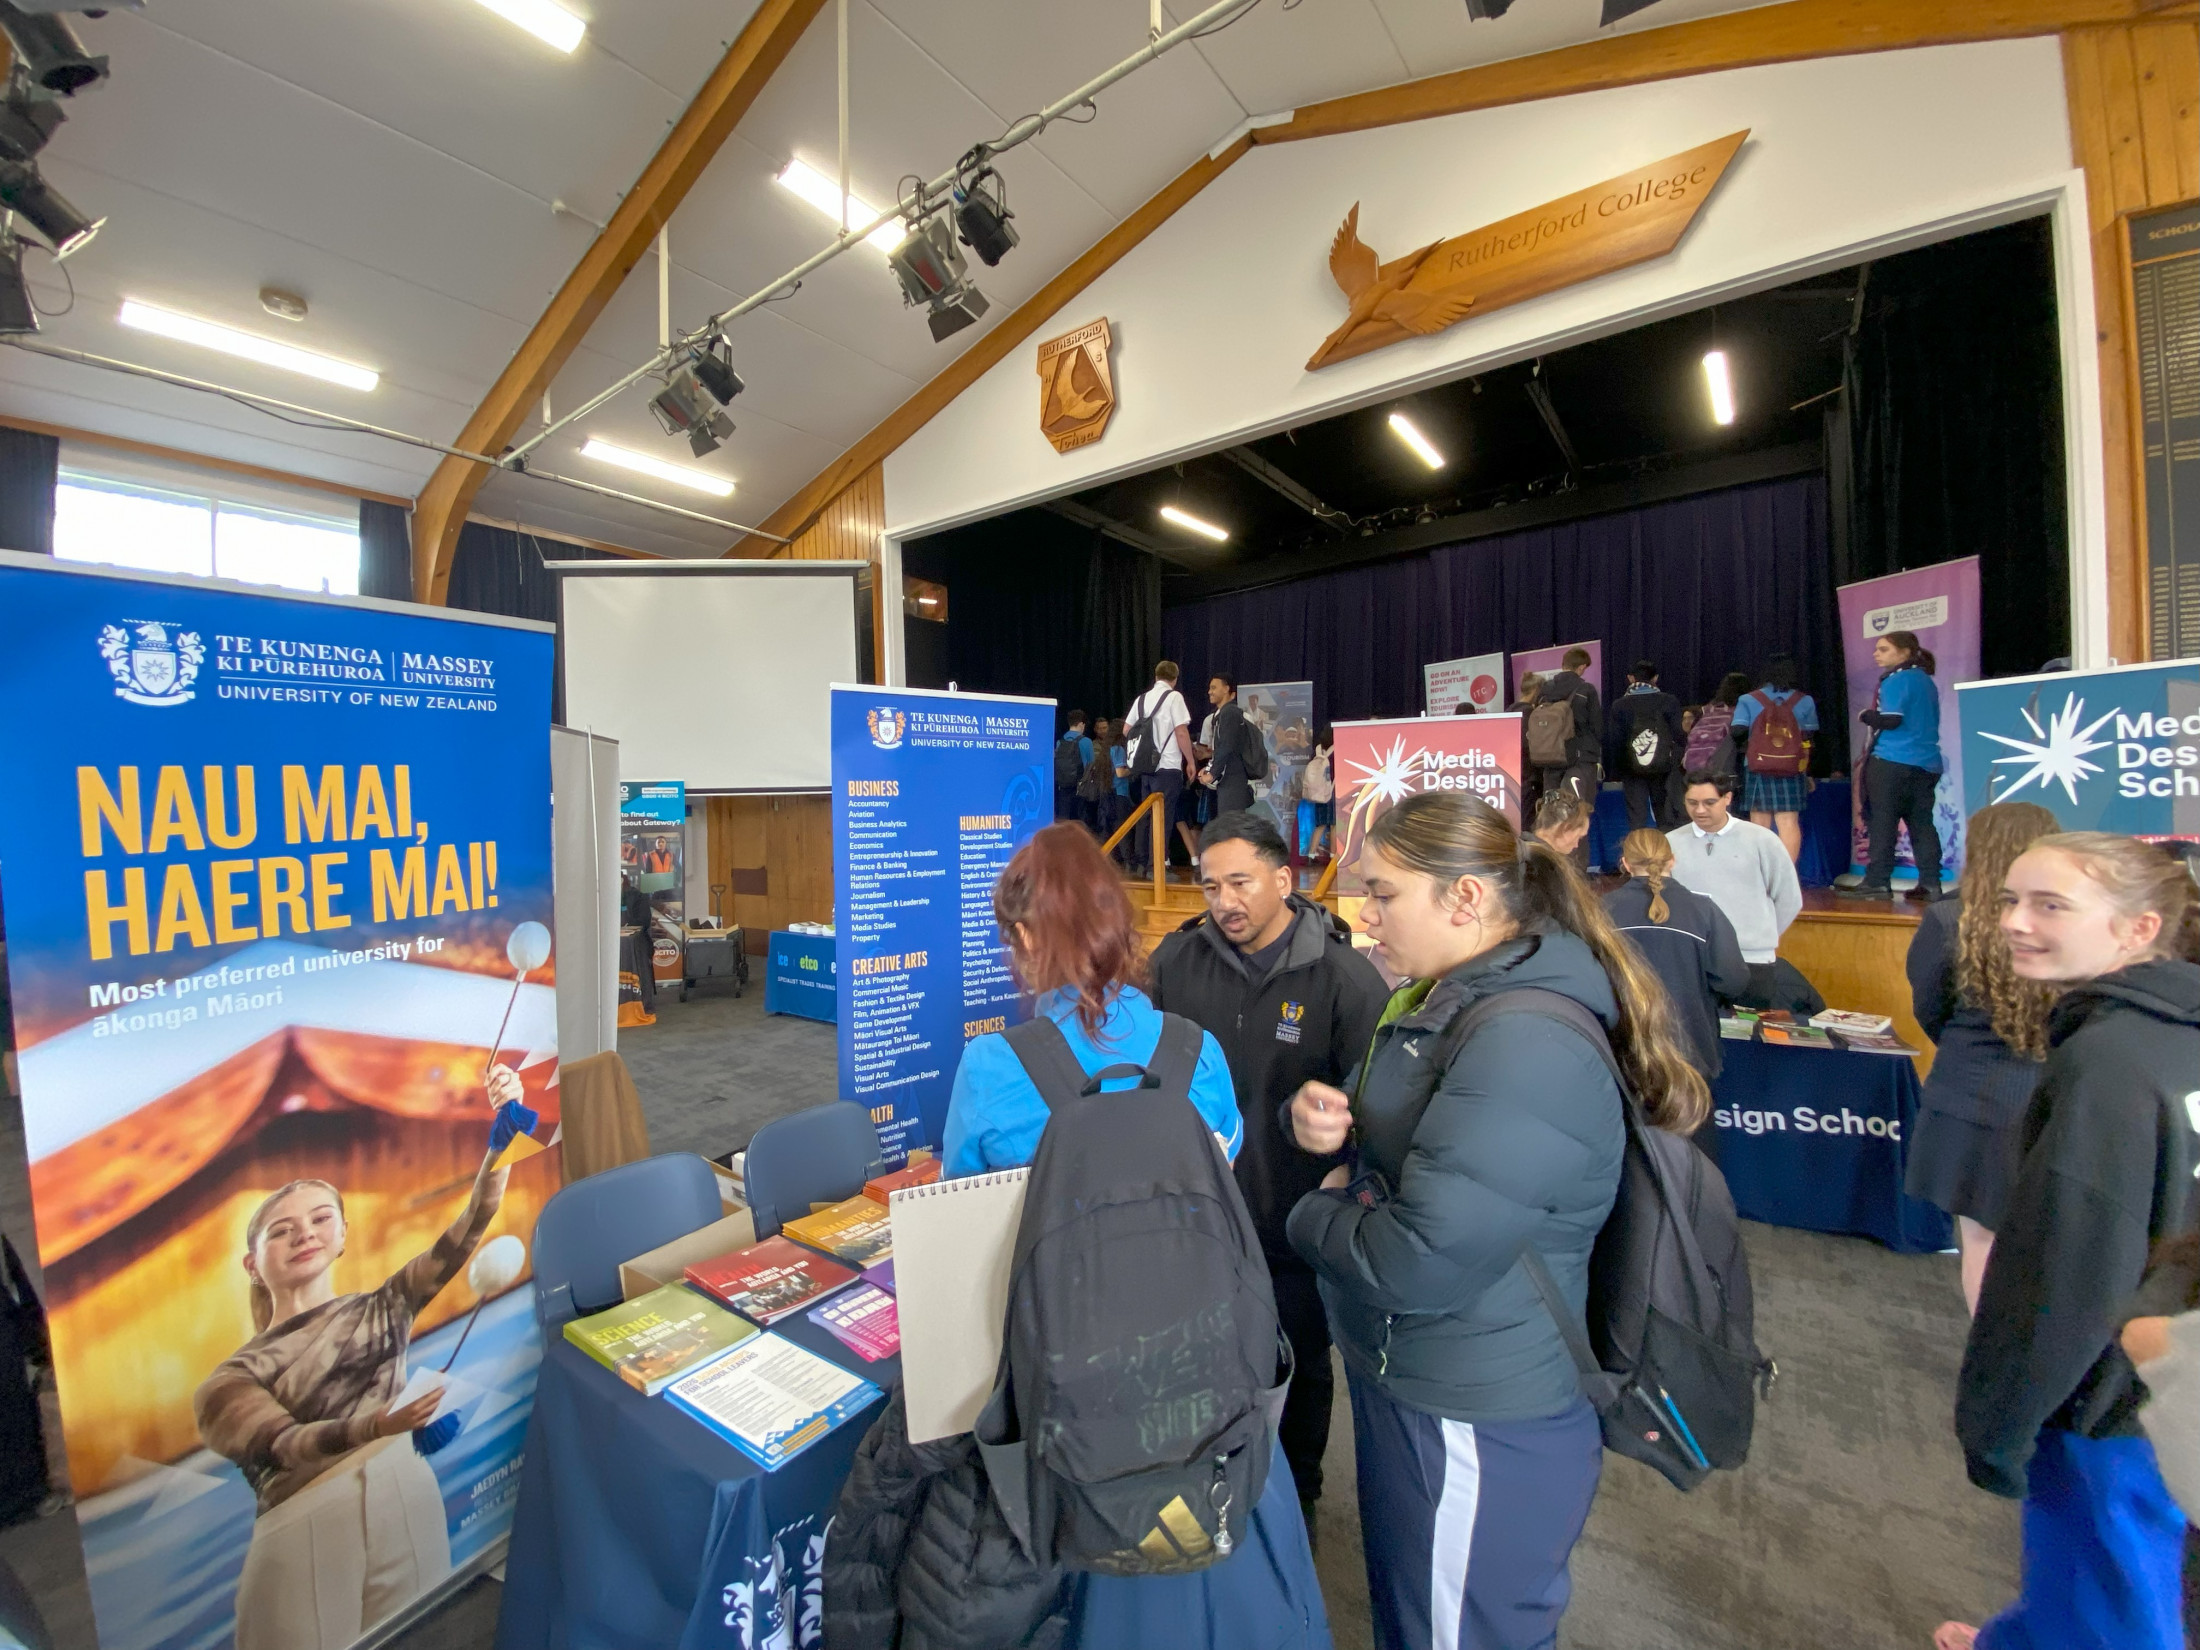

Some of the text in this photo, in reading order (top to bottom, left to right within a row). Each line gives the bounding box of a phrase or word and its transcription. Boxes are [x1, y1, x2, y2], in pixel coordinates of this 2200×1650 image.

[1450, 166, 1706, 273] Rutherford College
[2148, 222, 2200, 240] SCHOL
[1043, 325, 1101, 357] RUTHERFORD
[1894, 607, 1937, 619] AUCKLAND
[216, 635, 384, 665] TE KUNENGA
[217, 655, 385, 681] KI PŪREHUROA
[402, 652, 494, 676] MASSEY
[402, 672, 496, 690] UNIVERSITY
[1430, 676, 1469, 686] ADVENTURE
[218, 685, 497, 712] UNIVERSITY OF NEW ZEALAND
[1431, 696, 1459, 704] EXPLORE
[910, 712, 978, 725] TE KUNENGA
[986, 717, 1029, 729] MASSEY
[2116, 707, 2200, 740] Med
[911, 723, 979, 734] KI PŪREHUROA
[986, 728, 1029, 737] UNIVERSITY
[911, 738, 1029, 750] UNIVERSITY OF NEW ZEALAND
[1423, 749, 1495, 770] Media
[2117, 742, 2199, 769] Des
[848, 780, 899, 797] BUSINESS
[1423, 770, 1505, 794] Design
[2118, 768, 2199, 798] Sch
[77, 764, 429, 857] NAU MAI,
[848, 800, 889, 808] Accountancy
[879, 820, 907, 828] Analytics
[960, 815, 1012, 831] HUMANITIES
[849, 831, 897, 839] Communication
[960, 843, 993, 851] Development
[850, 852, 902, 860] Entrepreneurship
[850, 861, 907, 871] Finance Banking
[961, 862, 989, 870] Emergency
[875, 872, 905, 880] Resources
[913, 869, 945, 878] Employment
[961, 871, 979, 880] English
[851, 881, 880, 889] Relations
[84, 840, 498, 960] HAERE MAI!
[851, 892, 885, 900] Journalism
[961, 891, 980, 899] History
[851, 897, 930, 910] Management Leadership
[962, 901, 989, 909] Languages
[851, 913, 884, 921] Marketing
[852, 921, 896, 932] Media Studies
[852, 934, 880, 942] Property
[962, 929, 990, 938] Philosophy
[962, 940, 985, 948] Planning
[800, 954, 818, 971] etco
[852, 954, 901, 976] CREATIVE
[904, 951, 928, 969] ARTS
[963, 959, 992, 967] Psychology
[89, 935, 445, 1008] Most preferred university for
[963, 969, 985, 977] Security
[777, 976, 798, 984] SPECIALIST
[816, 982, 836, 991] TRAINING
[852, 973, 909, 986] Art Photography
[853, 983, 909, 997] Commercial Music
[963, 988, 986, 997] Teaching
[853, 991, 925, 1008] Fashion Textile Design
[964, 994, 1003, 1007] Teaching Kura
[92, 986, 284, 1038] ākonga Māori
[853, 1001, 919, 1018] Film, Animation VFX
[853, 1014, 912, 1029] Game Development
[964, 1016, 1005, 1037] SCIENCES
[875, 1027, 893, 1037] Visual
[894, 1025, 907, 1033] Arts
[894, 1035, 902, 1043] Toi
[854, 1041, 931, 1061] Spatial Industrial Design
[854, 1059, 896, 1072] Sustainability
[855, 1071, 889, 1083] Visual Arts
[855, 1069, 939, 1093] Visual Communication Design
[869, 1104, 893, 1124] ALTH
[900, 1117, 919, 1127] Health
[1714, 1103, 1901, 1140] sign Schoo
[880, 1131, 906, 1144] Nutrition
[793, 1260, 809, 1268] YOU
[591, 1311, 661, 1346] SCIENCE
[684, 1352, 758, 1395] FOR SCHOOL LEAVERS
[471, 1465, 508, 1499] JAEDYN
